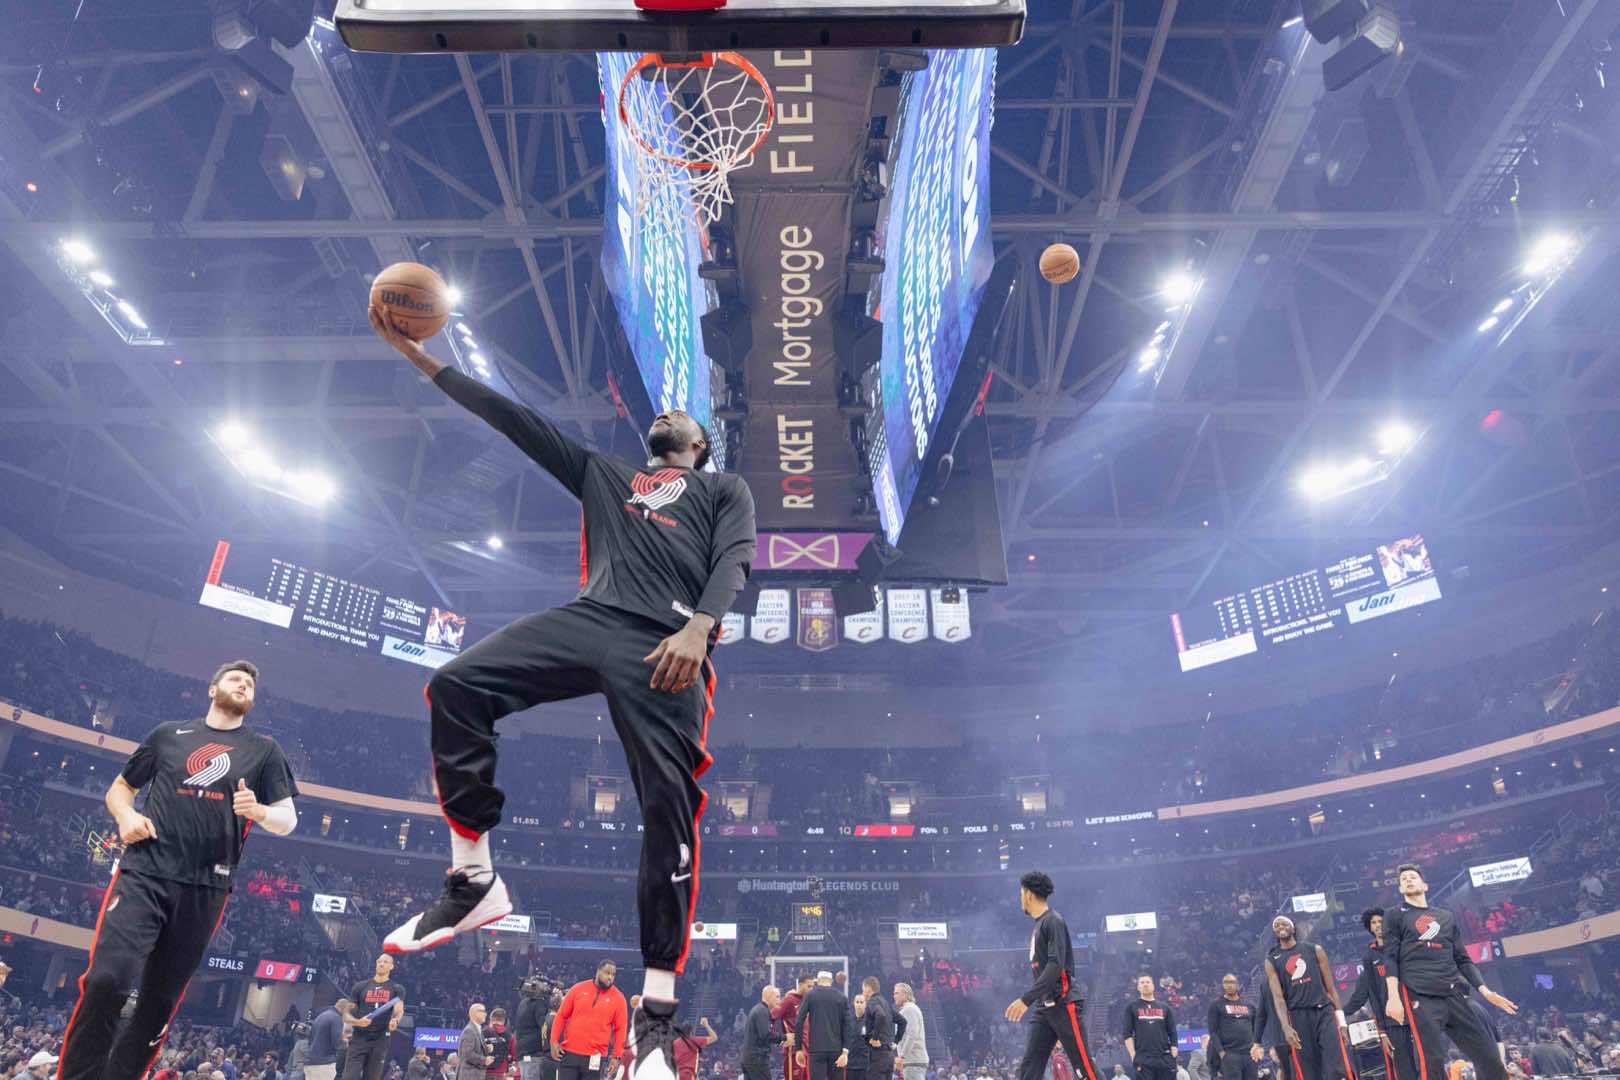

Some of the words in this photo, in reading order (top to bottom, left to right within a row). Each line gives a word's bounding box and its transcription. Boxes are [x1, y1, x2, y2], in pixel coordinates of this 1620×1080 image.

[381, 289, 433, 312] Wilson
[773, 225, 825, 385] Mortgage
[903, 206, 928, 461] INTRODUCTIONS
[917, 308, 937, 424] DURING
[777, 414, 814, 508] ROCKET
[368, 632, 380, 641] YOU
[751, 825, 758, 834] 0
[891, 826, 897, 835] 0
[753, 879, 810, 894] Huntington
[871, 880, 900, 891] CLUB
[208, 957, 244, 970] STEALS
[266, 964, 274, 976] 0
